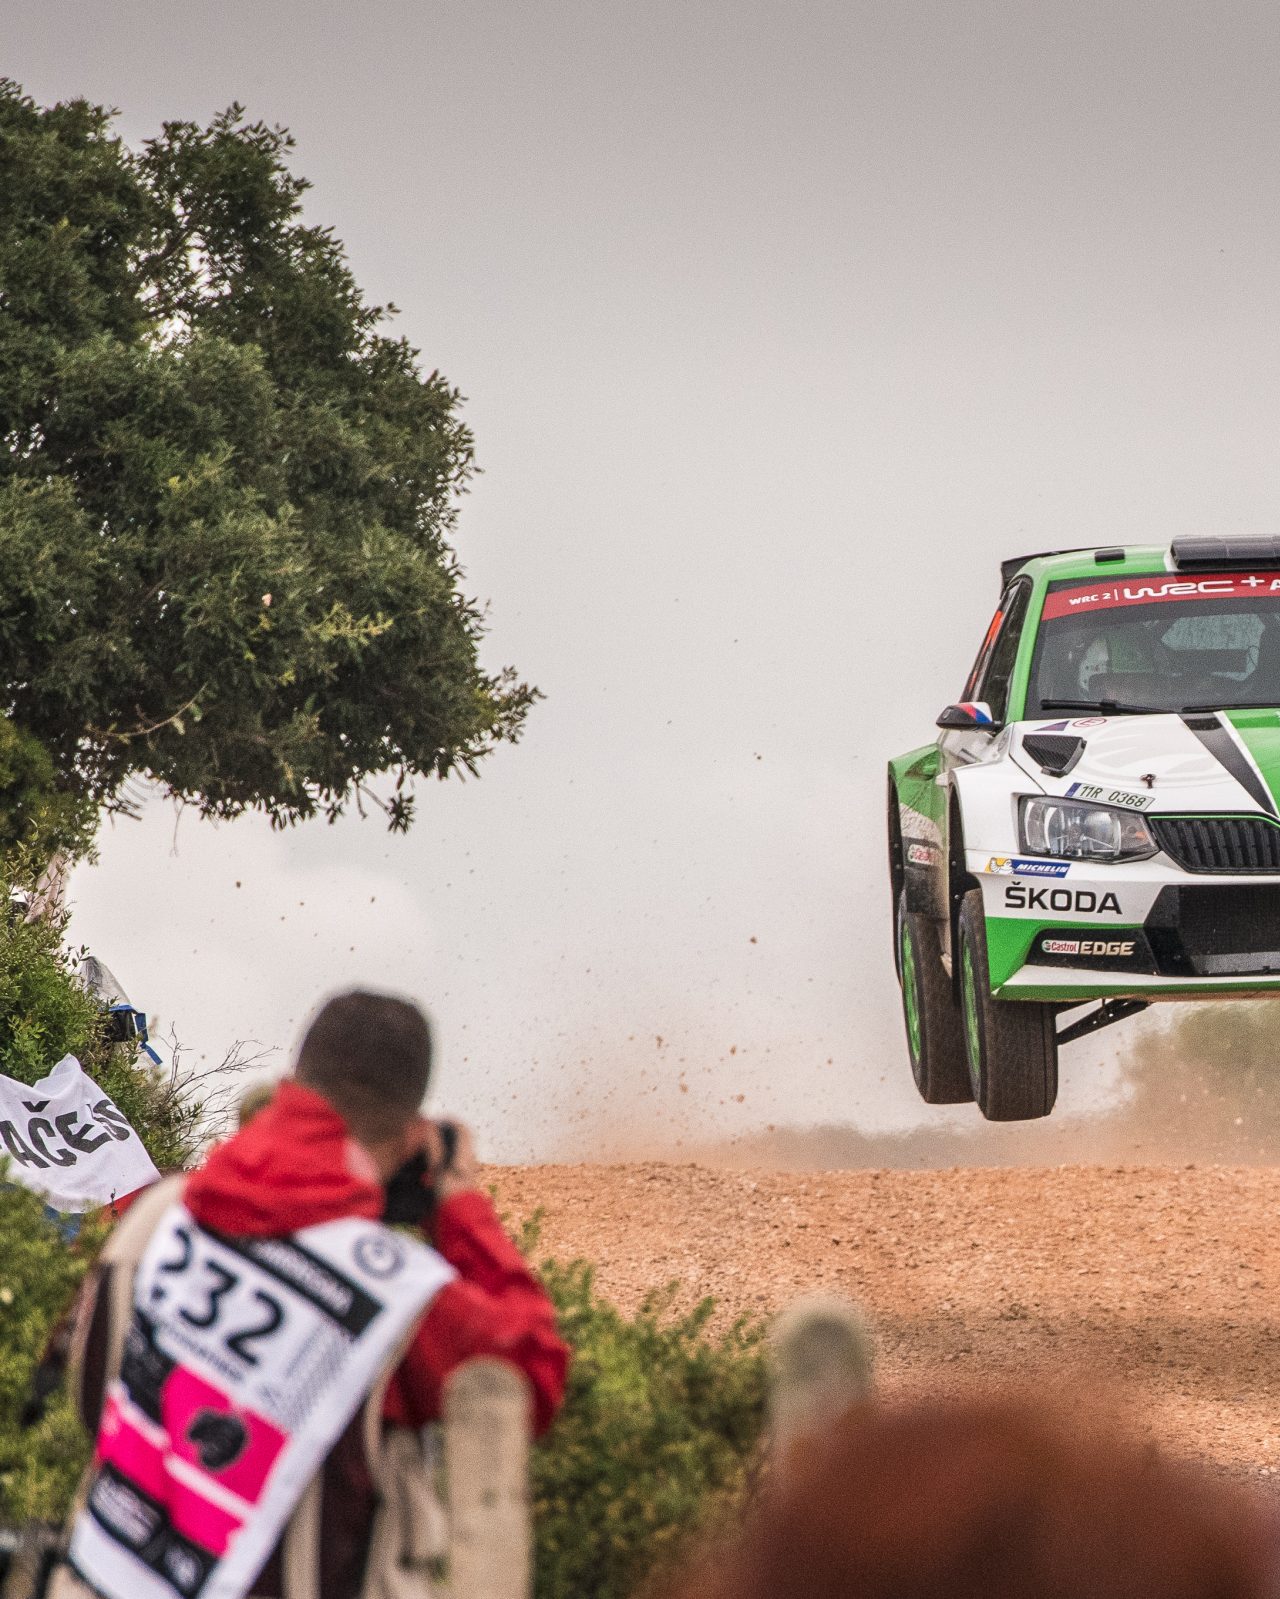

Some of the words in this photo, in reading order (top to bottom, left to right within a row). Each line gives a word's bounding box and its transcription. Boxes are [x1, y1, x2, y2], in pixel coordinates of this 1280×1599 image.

[1068, 593, 1099, 605] WRC
[1102, 592, 1111, 600] 2
[1123, 580, 1235, 599] WRC
[1080, 786, 1103, 798] 11R
[1108, 790, 1147, 807] 0368
[1015, 863, 1070, 873] MICHELIN
[1005, 881, 1123, 915] ŠKODA
[1051, 941, 1077, 953] Castrol
[1079, 941, 1136, 956] EDGE
[0, 1100, 131, 1169] AČES
